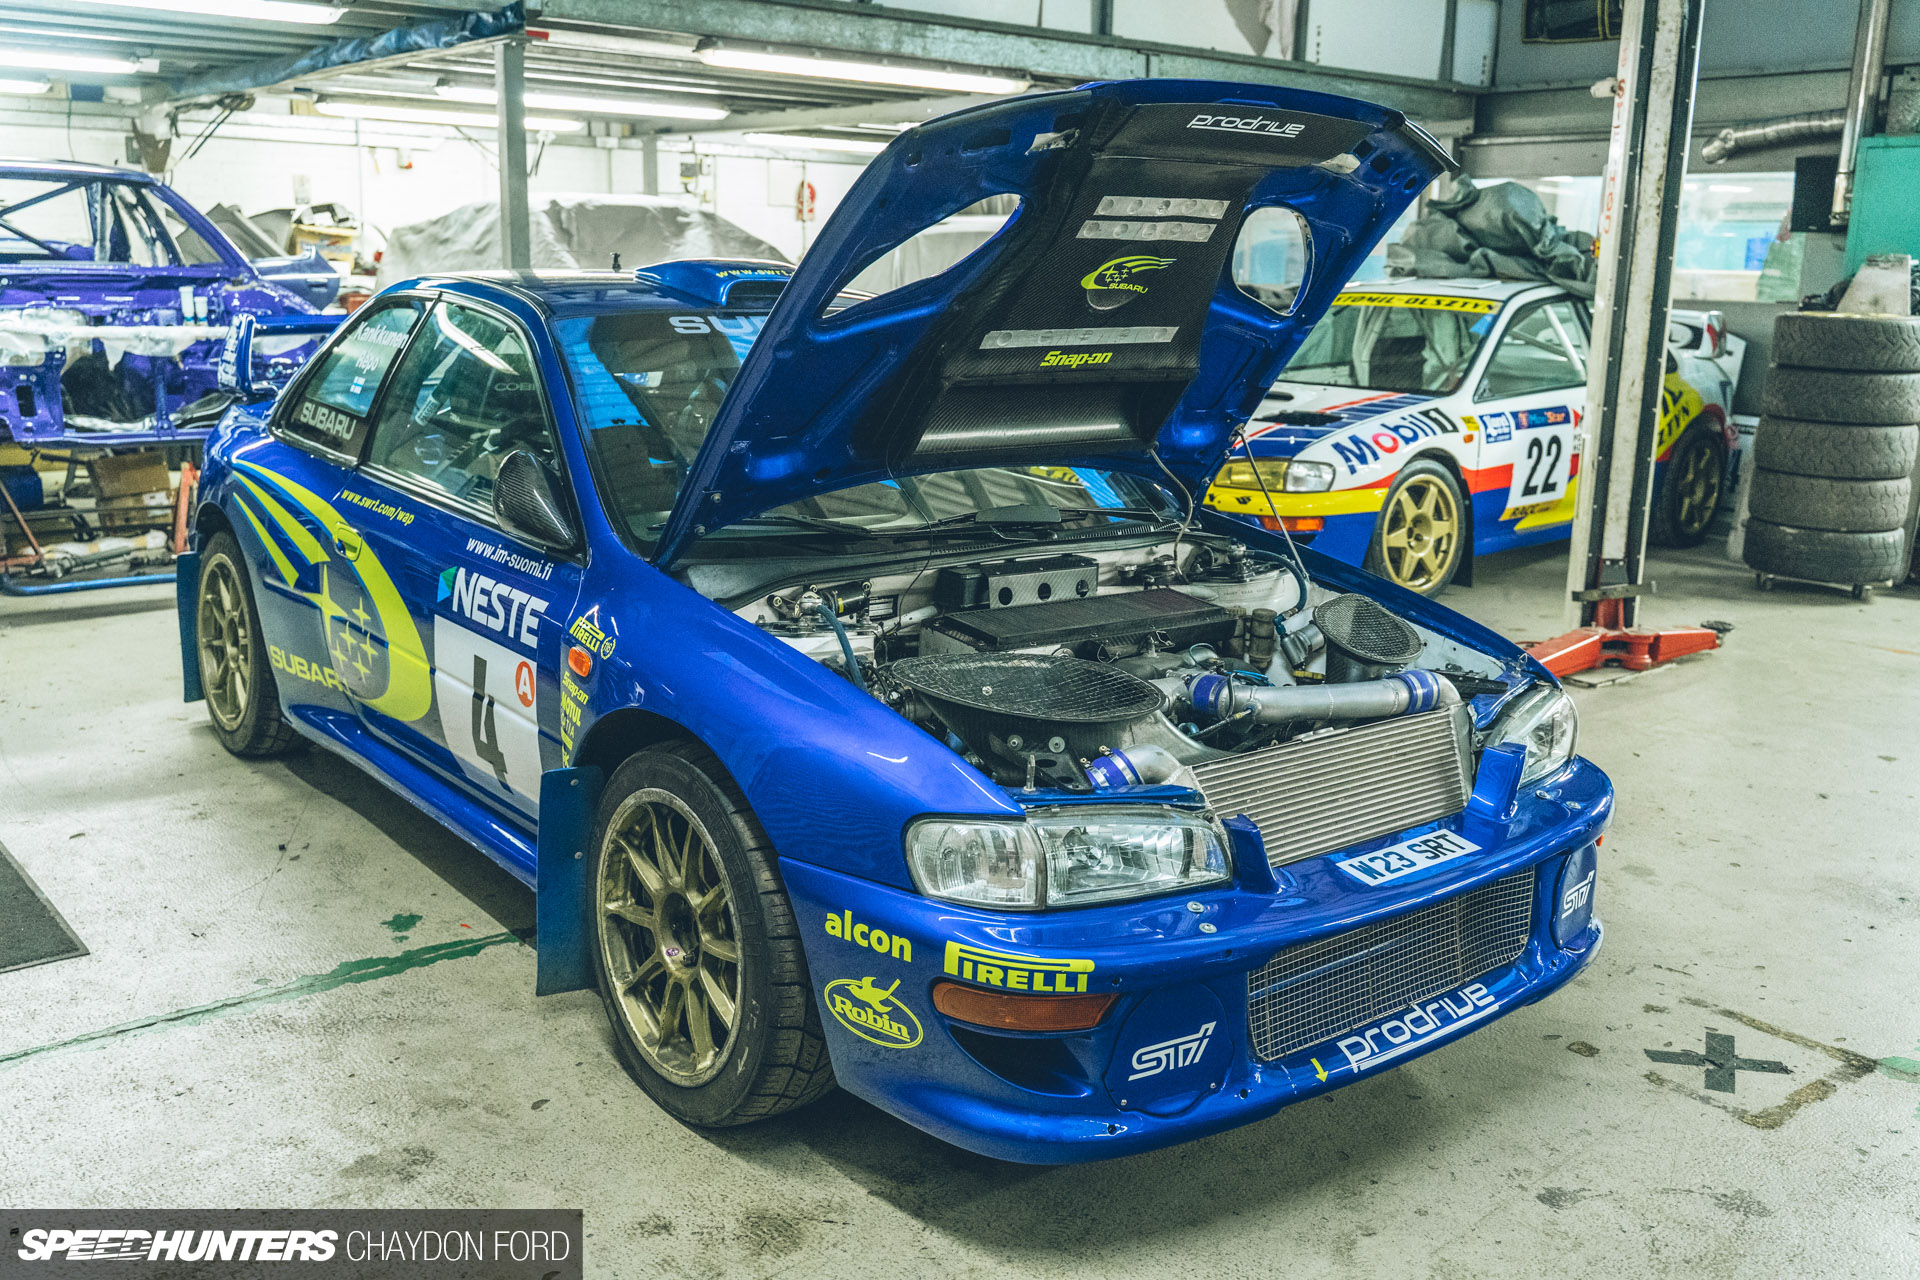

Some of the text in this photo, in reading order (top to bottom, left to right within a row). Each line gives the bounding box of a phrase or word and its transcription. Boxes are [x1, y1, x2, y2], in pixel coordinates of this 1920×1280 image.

[1186, 115, 1306, 136] prodrive
[716, 269, 795, 278] www.swrt.
[1108, 282, 1149, 294] SUBARU
[1404, 296, 1495, 312] OLSZTYN
[353, 320, 410, 350] Kankkunen
[355, 350, 380, 375] Repo
[1040, 350, 1113, 369] Snap-on
[300, 401, 357, 440] SUBARU
[1331, 413, 1438, 476] Mobil
[1521, 434, 1562, 498] 22
[340, 488, 415, 527] www.swrt.com/wap
[466, 538, 555, 582] www.im-suomi.fi
[452, 566, 549, 650] NESTE
[569, 616, 605, 653] PIRELLI
[517, 664, 533, 702] A
[562, 671, 589, 705] Snap-on
[471, 653, 515, 796] 4
[560, 691, 582, 727] MOTUL
[1348, 833, 1467, 881] W23 SRT
[824, 909, 912, 963] alcon
[943, 940, 1096, 993] PIRELLI
[833, 993, 910, 1042] Robin
[1336, 982, 1496, 1074] prodrive
